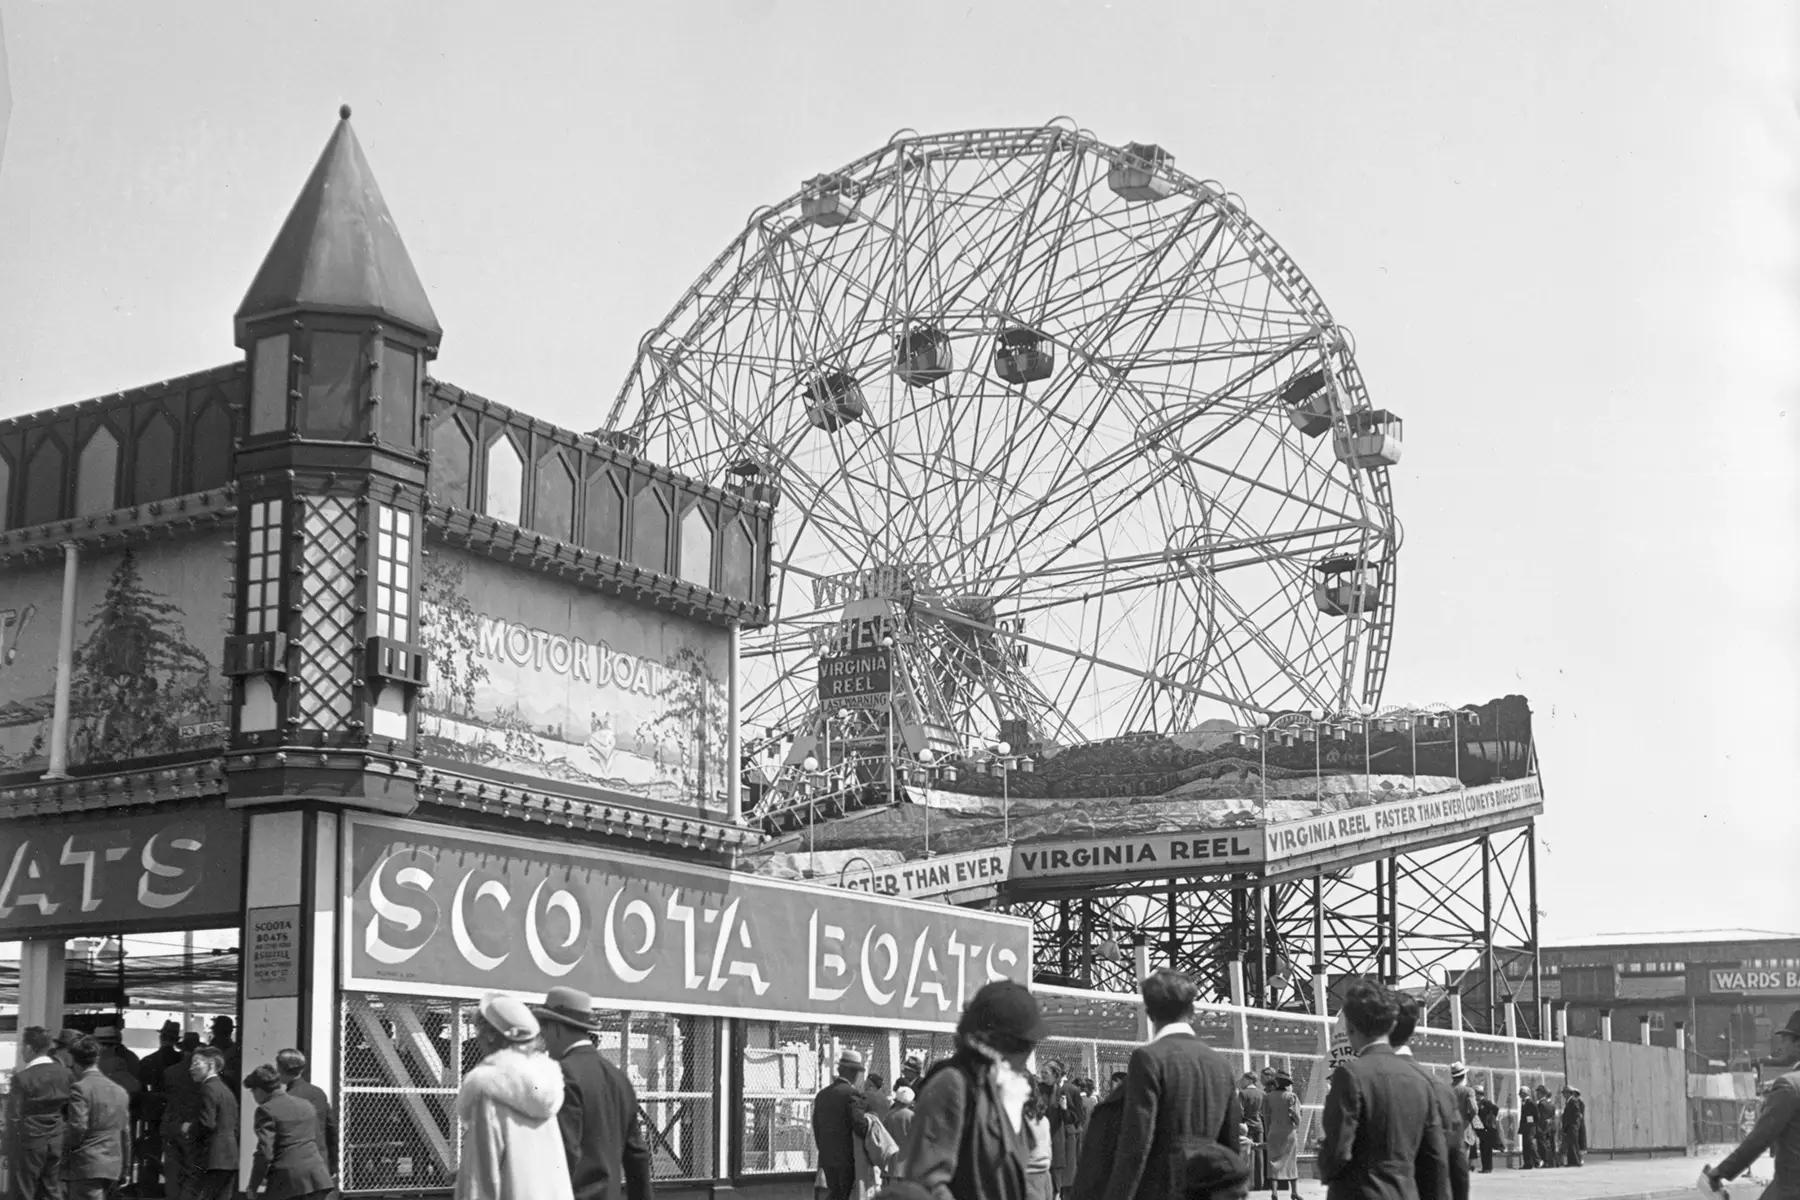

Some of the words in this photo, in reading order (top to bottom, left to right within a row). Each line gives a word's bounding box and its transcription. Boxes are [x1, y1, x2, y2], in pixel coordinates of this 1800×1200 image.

[476, 612, 592, 683] MOTOR
[820, 656, 887, 678] VIRGINIA
[833, 676, 875, 694] REEL
[844, 693, 887, 709] WARNING
[1268, 820, 1337, 852] VIRGINIA
[1338, 813, 1371, 838] REEL
[1375, 806, 1417, 830] FASTER
[1417, 804, 1442, 821] THAN
[1442, 798, 1464, 817] EVER
[1465, 790, 1495, 812] CONEY'S
[1495, 786, 1522, 806] BIGGEST
[1020, 843, 1157, 871] VIRGINIA
[1170, 837, 1250, 861] REEL
[902, 865, 951, 891] THAN
[955, 857, 1003, 882] EVER
[255, 921, 292, 932] SCOOTA
[364, 848, 770, 995] SCOOTA
[257, 932, 289, 942] BOATS
